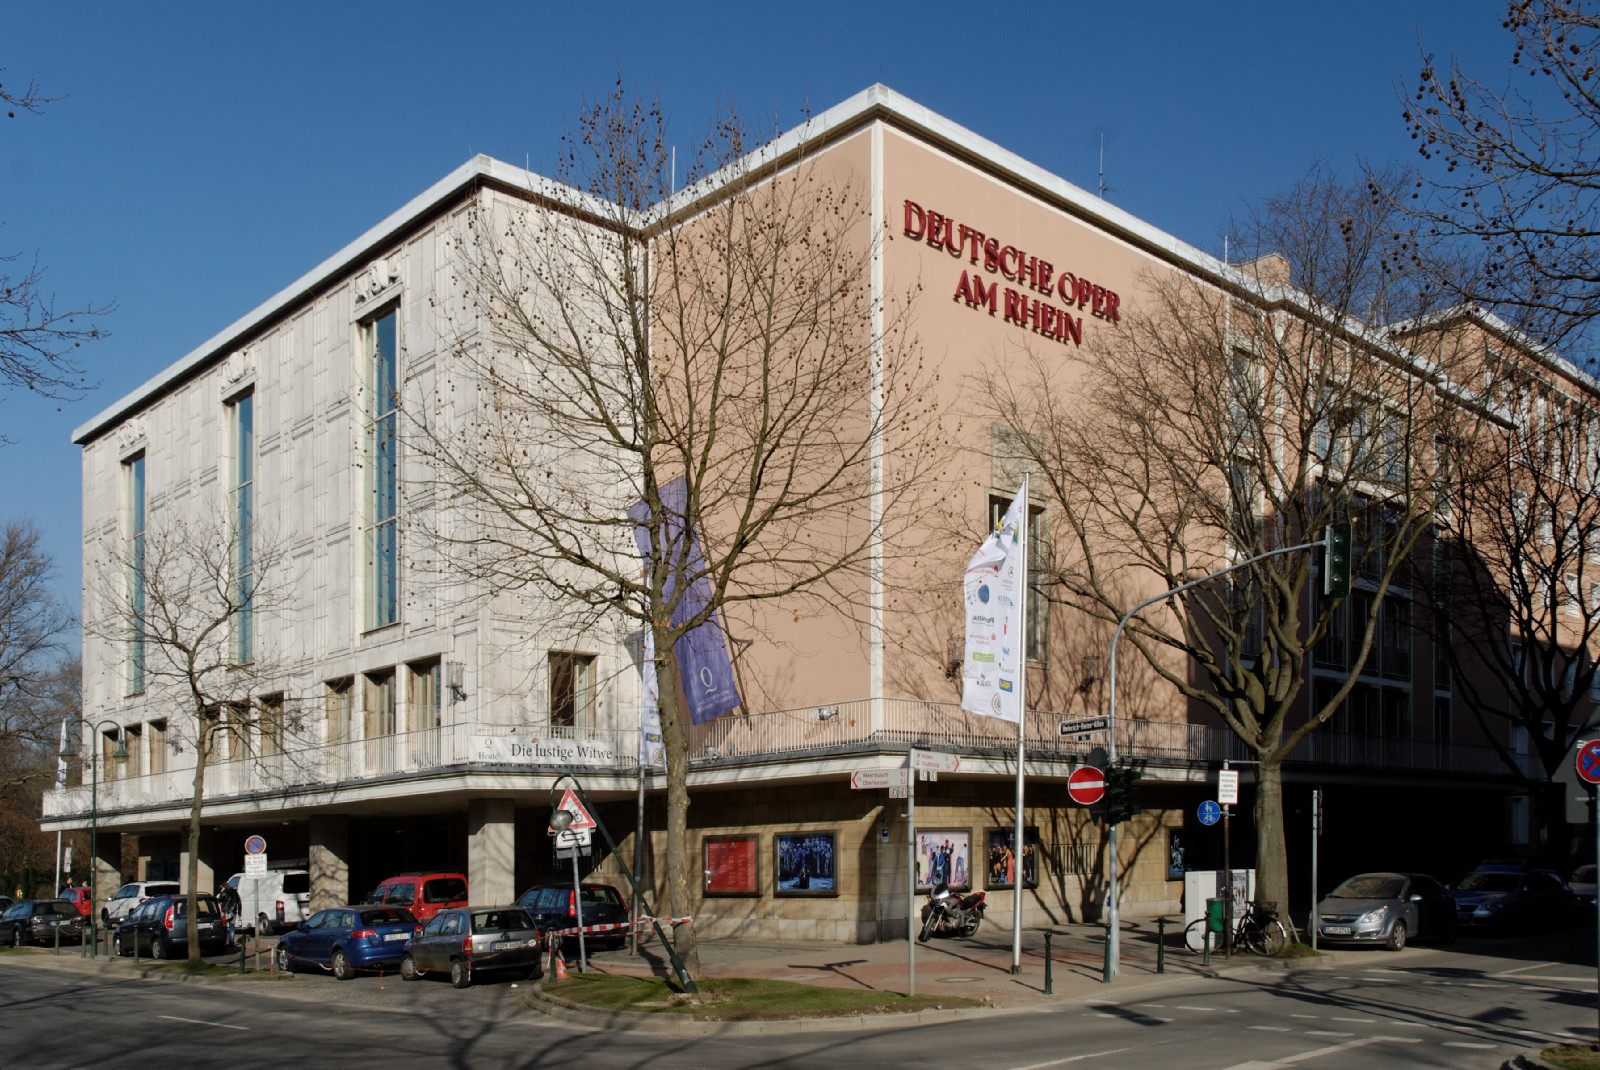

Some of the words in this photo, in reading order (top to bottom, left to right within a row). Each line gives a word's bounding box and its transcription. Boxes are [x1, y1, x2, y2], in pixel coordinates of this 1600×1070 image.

[904, 199, 1055, 292] DEUTSCHE
[1057, 271, 1121, 321] OPER
[954, 269, 999, 312] AM
[1004, 287, 1083, 345] RHEIN
[478, 751, 499, 760] Heute
[511, 743, 533, 757] Die
[535, 743, 574, 762] lustige
[576, 745, 613, 760] Witwe
